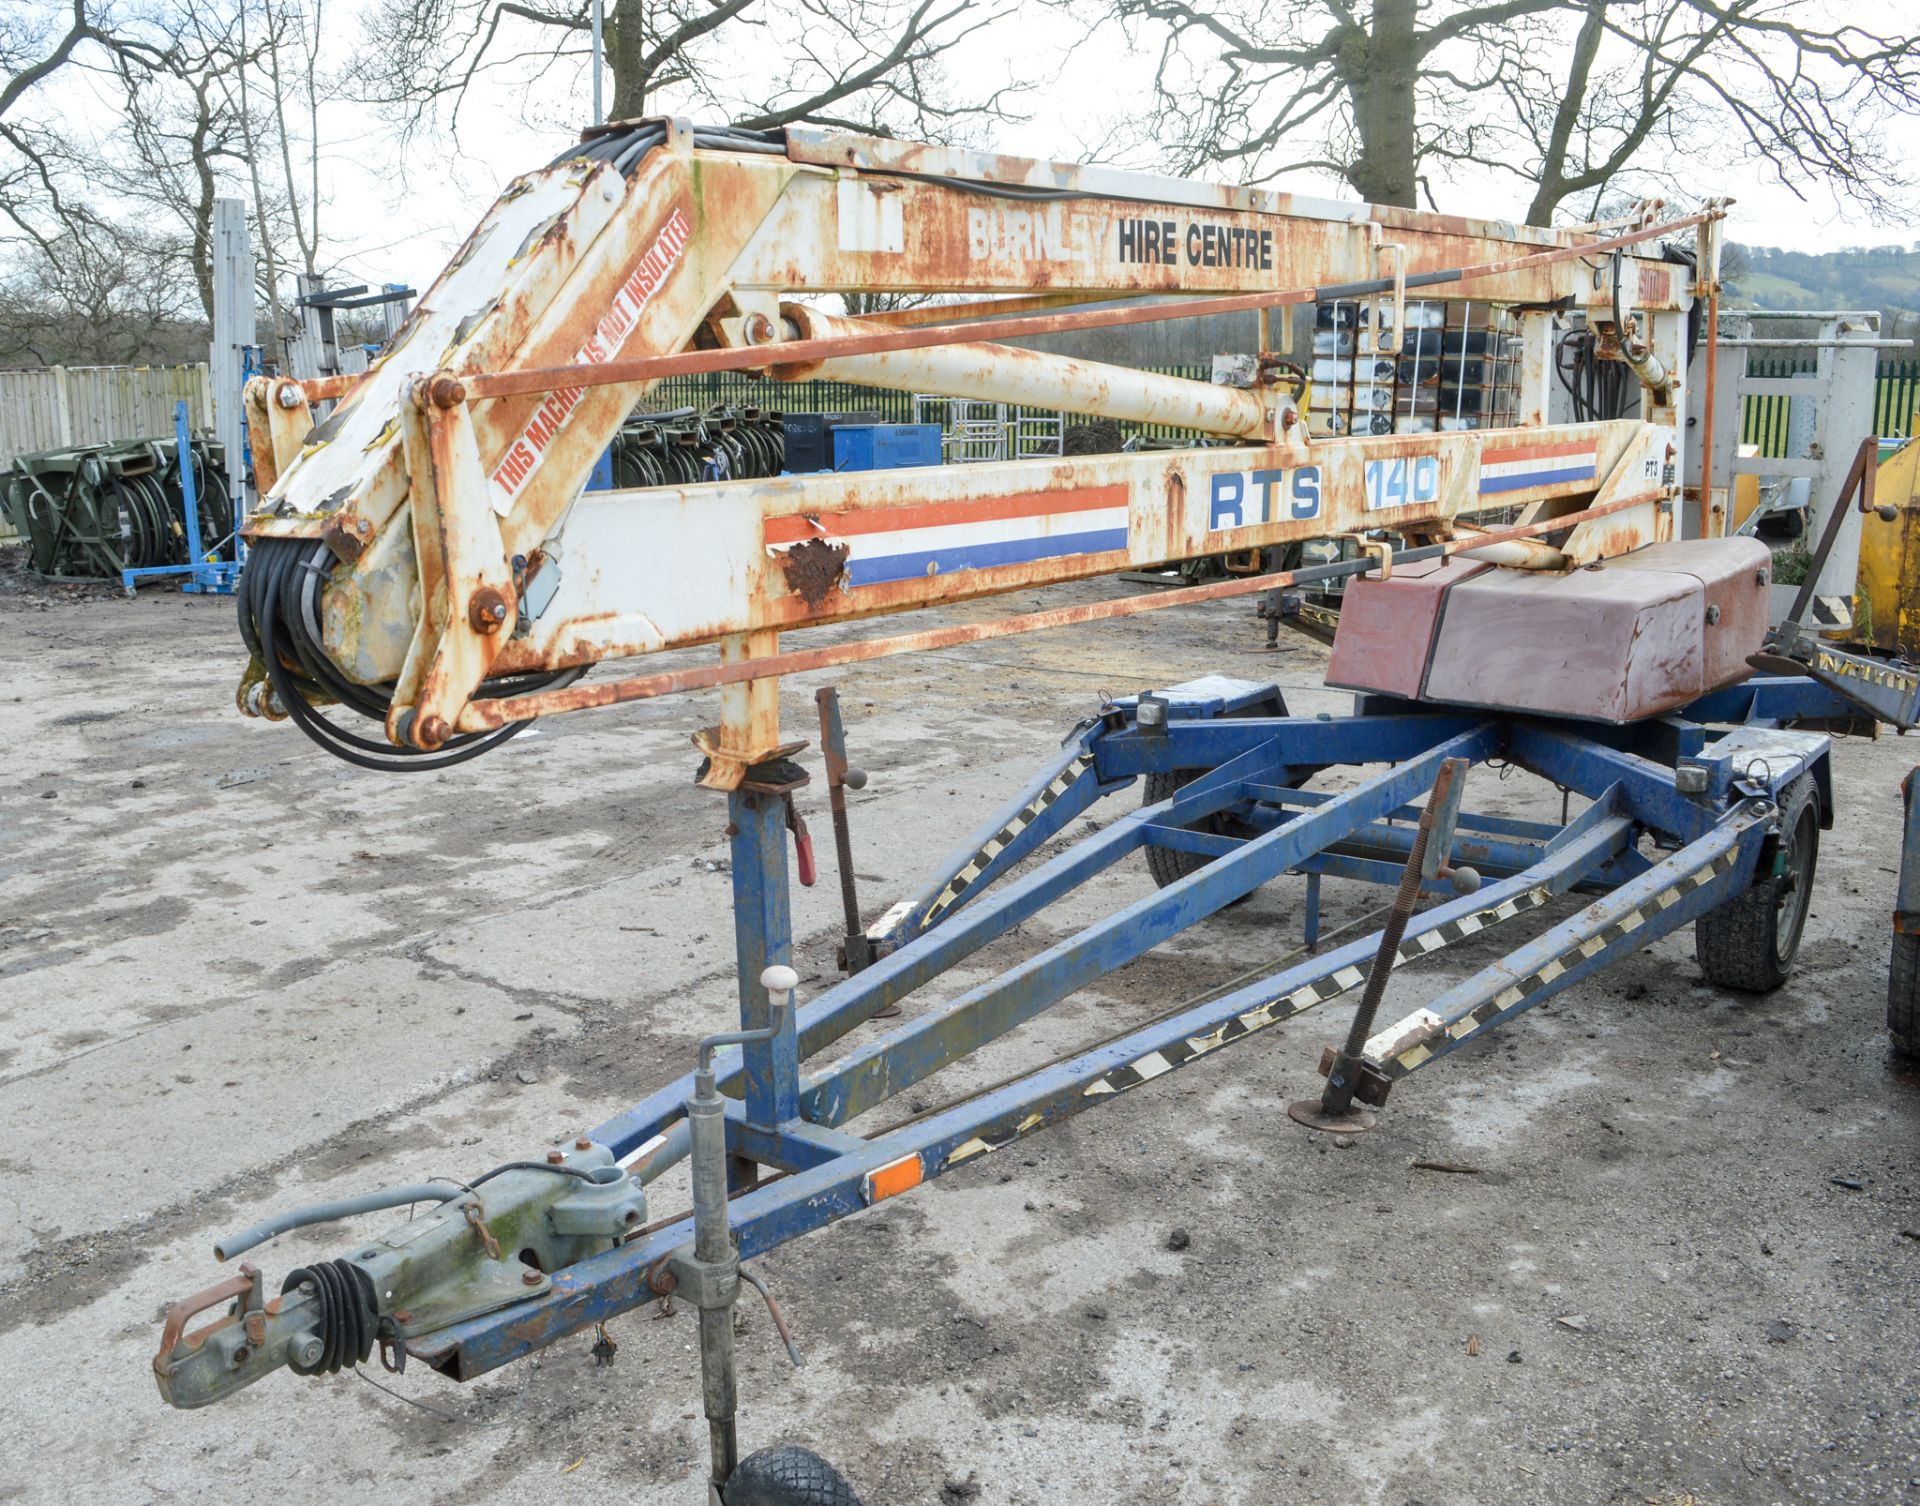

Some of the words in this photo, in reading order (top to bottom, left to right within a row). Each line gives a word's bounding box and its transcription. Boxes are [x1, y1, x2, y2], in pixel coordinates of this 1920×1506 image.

[968, 207, 1107, 274] BURNLEY
[1118, 218, 1177, 266] HIRE
[1186, 223, 1272, 271] CENTRE
[493, 440, 536, 496] THIS
[525, 364, 587, 452] MACHI
[582, 336, 607, 364] IS
[598, 299, 633, 347] NOT
[623, 210, 691, 309] INSULATED
[1210, 466, 1320, 530] RTS
[1367, 457, 1438, 508] 140
